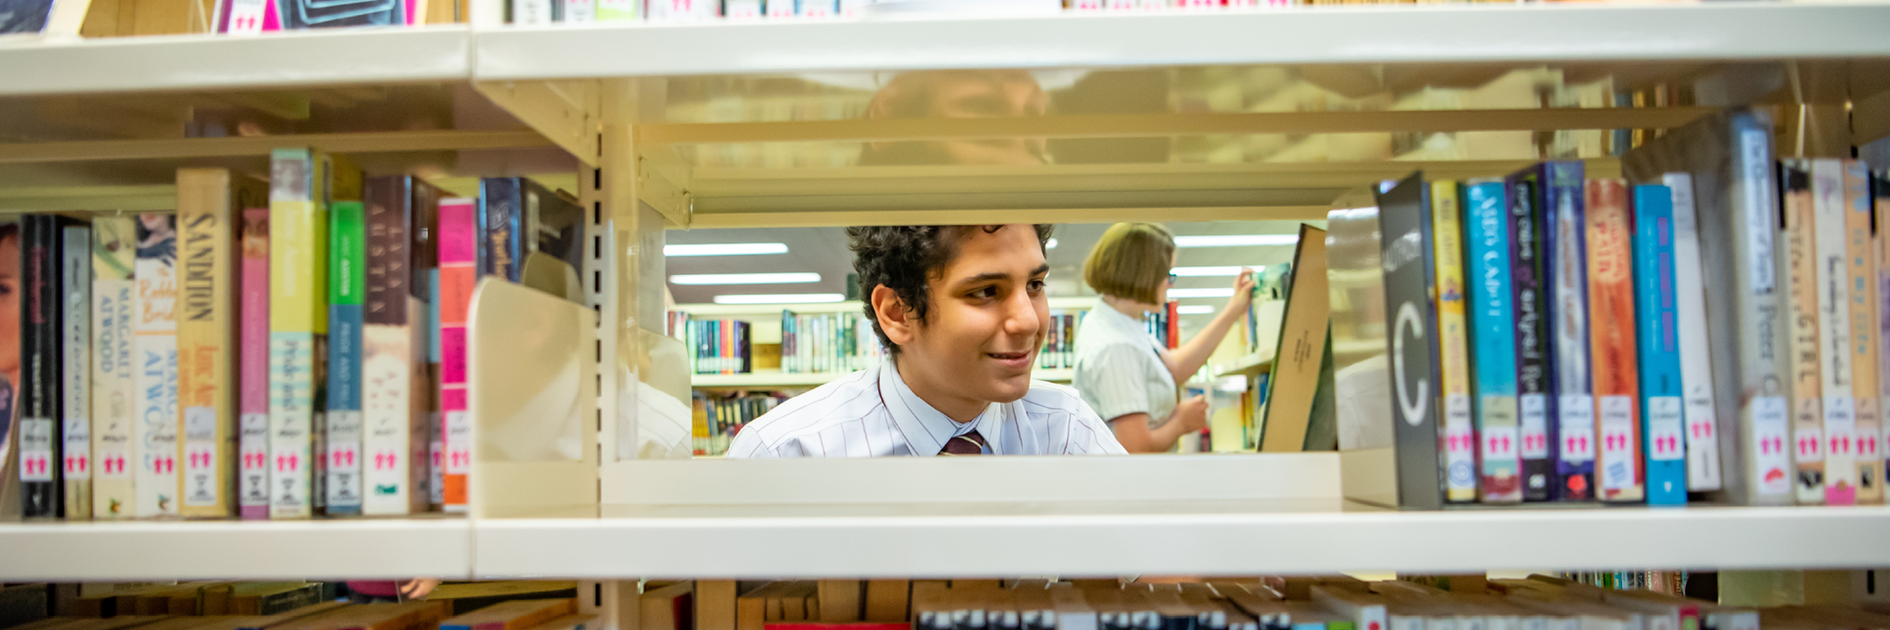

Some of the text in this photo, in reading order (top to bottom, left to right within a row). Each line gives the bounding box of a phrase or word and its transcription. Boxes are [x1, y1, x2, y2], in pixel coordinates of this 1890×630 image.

[182, 212, 216, 322] SANDITON
[370, 203, 388, 314] AUSTIN
[100, 296, 113, 373] ATWOOD
[117, 287, 131, 379] MARGARET
[1393, 301, 1428, 427] C
[1759, 304, 1779, 359] Peter
[1796, 314, 1818, 383] GIRL
